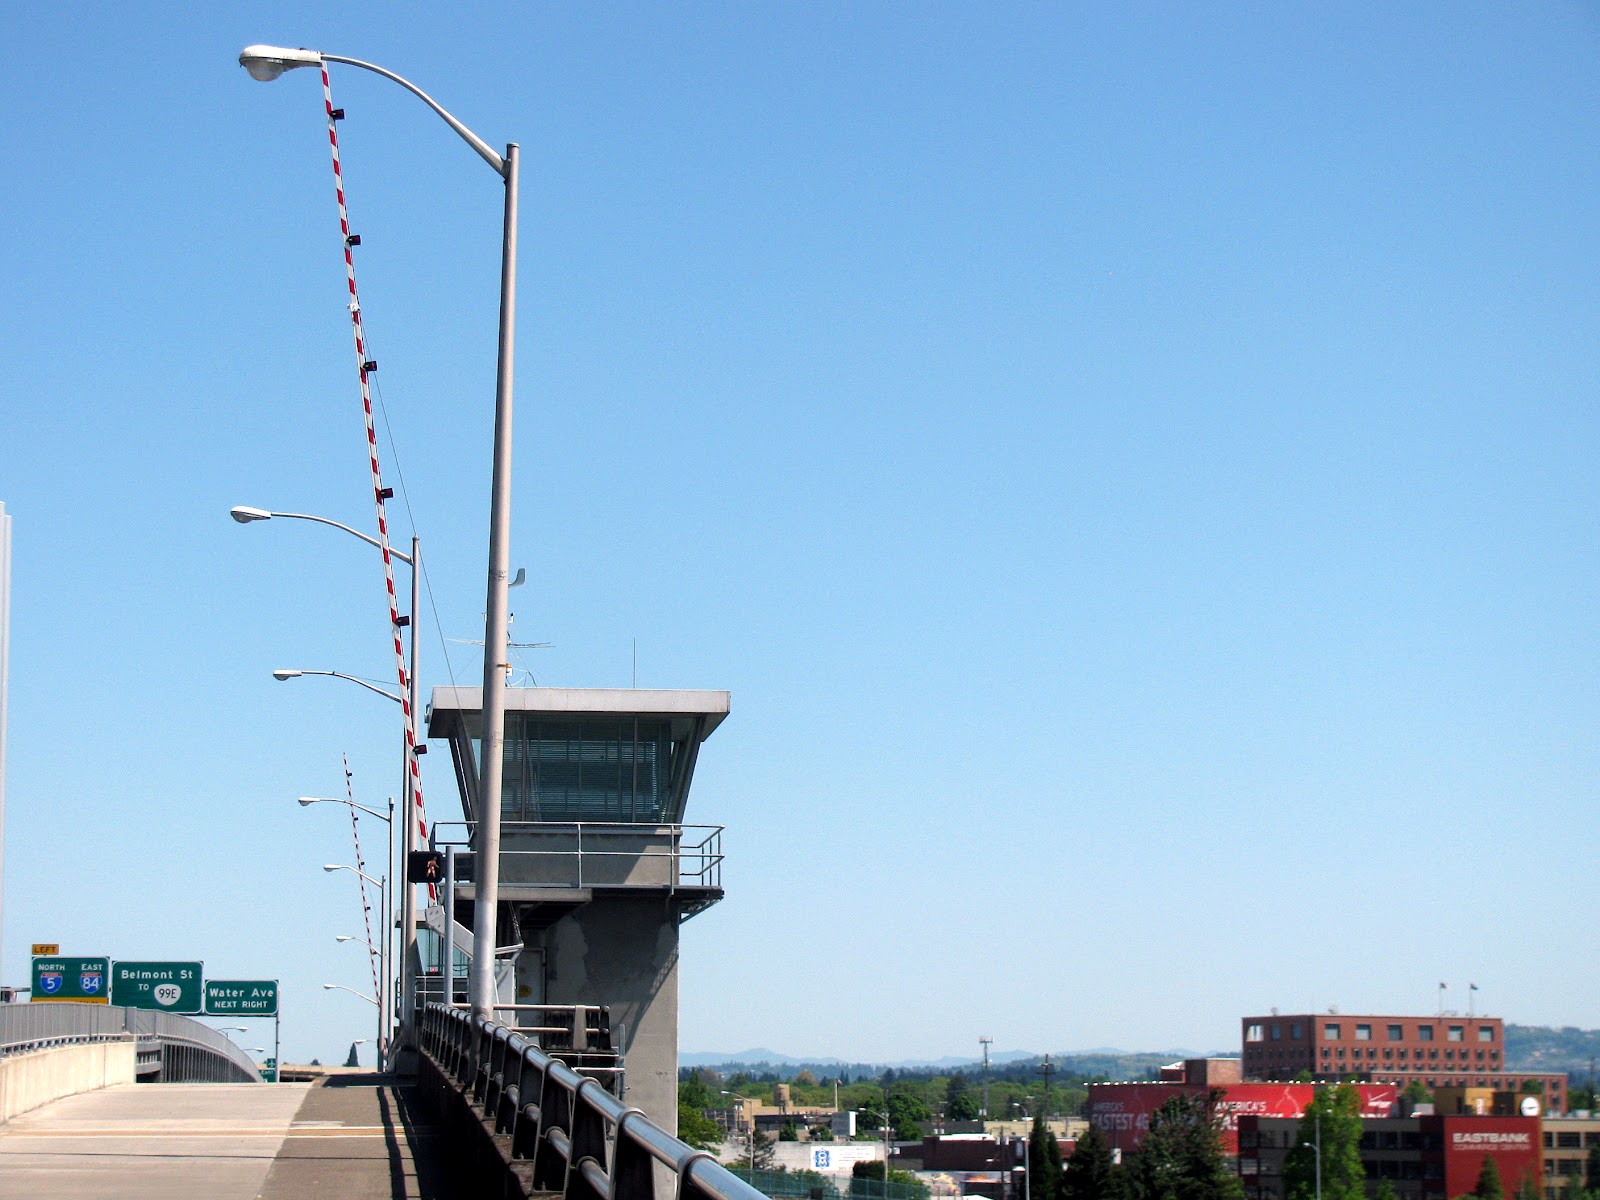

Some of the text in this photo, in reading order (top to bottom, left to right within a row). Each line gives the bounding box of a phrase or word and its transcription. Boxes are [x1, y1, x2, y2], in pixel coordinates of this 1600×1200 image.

[34, 946, 57, 954] LEFT
[121, 970, 193, 979] Belmont St
[47, 977, 99, 989] 5 84
[158, 988, 177, 998] 99E
[209, 988, 274, 997] Water Ave
[1214, 1101, 1267, 1112] AMERICA'S
[1092, 1113, 1135, 1130] FASTEST
[1452, 1132, 1529, 1143] EASTBANK
